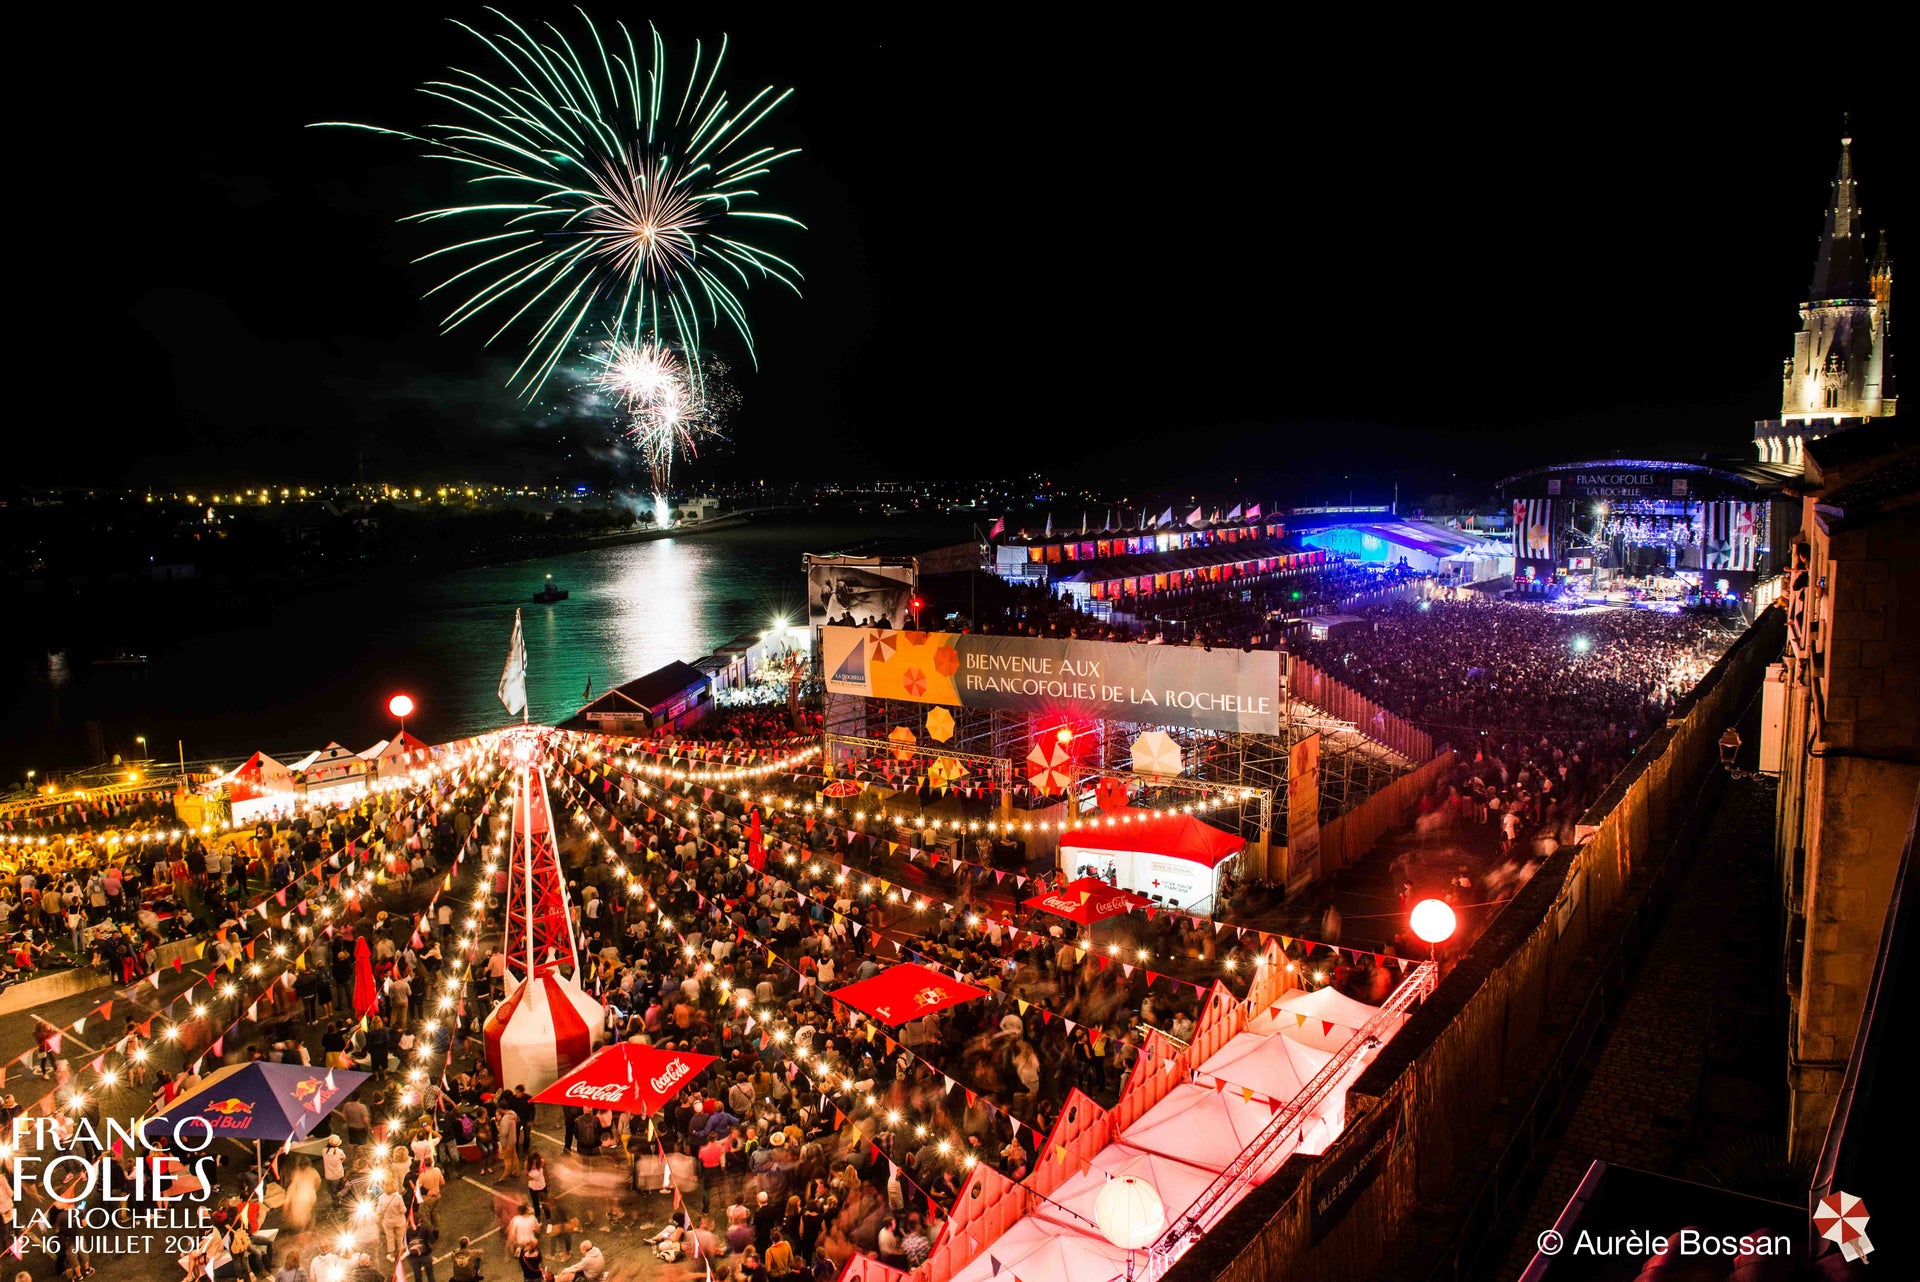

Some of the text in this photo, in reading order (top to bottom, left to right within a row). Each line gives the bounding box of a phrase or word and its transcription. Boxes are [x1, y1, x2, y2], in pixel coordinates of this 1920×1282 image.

[1576, 475, 1654, 485] FRANCOFOLIES
[1586, 488, 1598, 496] LA
[966, 653, 1101, 678] BIENVENUE AUX
[966, 675, 1271, 715] FRANCOFOLIES DE LA ROCHELLE
[220, 1116, 253, 1129] Bull
[1318, 1187, 1337, 1216] VILLE
[1338, 1174, 1349, 1195] DE
